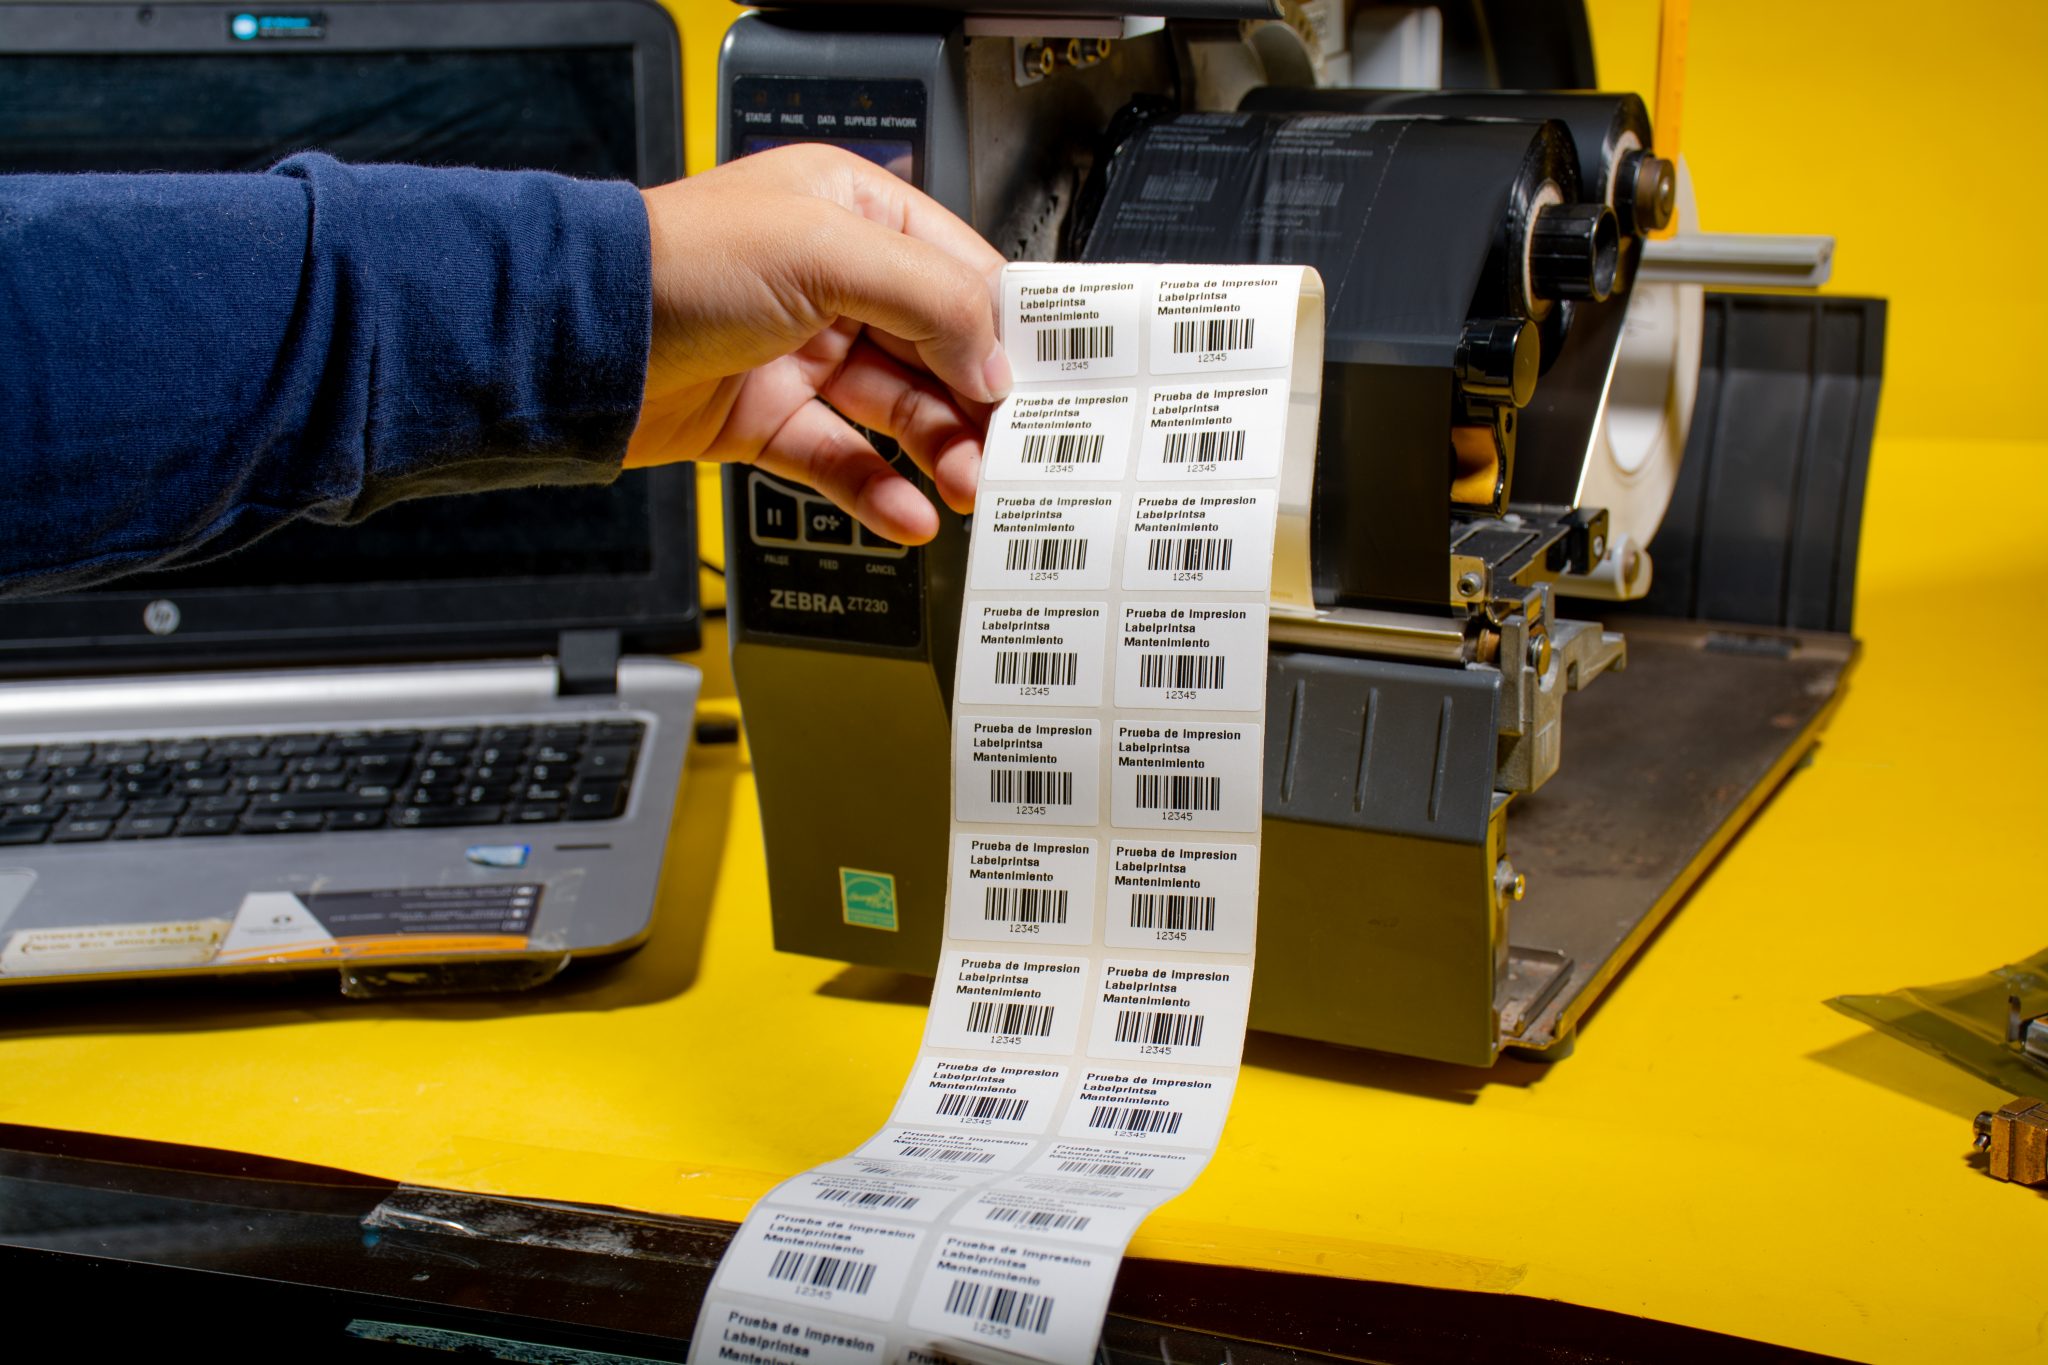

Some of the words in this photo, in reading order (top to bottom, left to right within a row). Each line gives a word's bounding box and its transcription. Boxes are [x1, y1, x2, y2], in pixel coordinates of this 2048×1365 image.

[745, 112, 772, 123] STATUS
[781, 113, 804, 124] PAUSE
[817, 115, 836, 125] DATA
[844, 116, 877, 126] SUPPLIES
[881, 117, 917, 127] NETWORK
[1020, 285, 1059, 296] Prueba
[1062, 284, 1075, 294] de
[1079, 282, 1134, 293] Impresion
[1160, 280, 1200, 289] Prueba
[1203, 280, 1217, 288] de
[1221, 278, 1278, 288] Impresion
[1158, 292, 1227, 302] Labelprintsa
[1020, 298, 1086, 310] Labelprintsa
[1157, 303, 1240, 315] Mantenimiento
[1020, 310, 1099, 324] Mantenimiento
[1197, 352, 1227, 363] 12345
[1061, 360, 1089, 371] 12345
[1015, 397, 1054, 406] Prueba
[1057, 396, 1071, 405] de
[1074, 394, 1129, 406] Impresion
[1153, 391, 1192, 402] Prueba
[1195, 390, 1210, 400] de
[1213, 387, 1268, 399] Impresion
[1012, 409, 1080, 418] Labelprintsa
[1152, 403, 1219, 415] Labelprintsa
[1010, 420, 1092, 429] Mantenimiento
[1150, 415, 1232, 428] Mantenimiento
[1044, 464, 1074, 473] 12345
[1186, 463, 1217, 473] 12345
[996, 497, 1036, 506] Prueba
[1039, 497, 1053, 506] de
[1056, 497, 1112, 507] Impresion
[1138, 497, 1178, 506] Prueba
[1181, 497, 1196, 506] de
[1199, 496, 1256, 507] Impresion
[994, 510, 1062, 520] Labelprintsa
[1136, 509, 1206, 520] Labelprintsa
[993, 523, 1075, 532] Mantenimiento
[1134, 522, 1219, 532] Mantenimiento
[819, 559, 839, 570] FEED
[866, 563, 896, 576] CANCEL
[1029, 571, 1059, 581] 12345
[1172, 572, 1204, 582] 12345
[770, 588, 845, 614] ZEBRA
[847, 596, 888, 613] ZT230
[983, 607, 1022, 617] Prueba
[1026, 607, 1040, 617] de
[1043, 607, 1099, 618] Impresion
[1125, 608, 1167, 618] Prueba
[1170, 608, 1185, 619] de
[1188, 608, 1246, 621] Impresion
[981, 620, 1050, 632] Labelprintsa
[1124, 622, 1196, 634] Labelprintsa
[980, 634, 1064, 645] Mantenimiento
[1123, 636, 1210, 648] Mantenimiento
[1019, 686, 1050, 696] 12345
[1165, 690, 1197, 700] 12345
[974, 722, 1014, 734] Prueba
[1017, 724, 1032, 734] de
[1035, 724, 1092, 736] Impresion
[1119, 727, 1160, 738] Prueba
[1164, 728, 1178, 739] de
[1182, 728, 1241, 741] Impresion
[973, 737, 1043, 750] Labelprintsa
[1118, 741, 1190, 754] Labelprintsa
[973, 751, 1057, 764] Mantenimiento
[1118, 756, 1205, 769] Mantenimiento
[1016, 805, 1046, 815] 12345
[1162, 811, 1193, 821] 12345
[971, 840, 1011, 851] Prueba
[1014, 841, 1029, 852] de
[1033, 842, 1089, 855] Impresion
[1116, 846, 1157, 858] Prueba
[1160, 847, 1175, 858] de
[1179, 848, 1237, 861] Impresion
[970, 854, 1040, 867] Labelprintsa
[1115, 860, 1186, 874] Labelprintsa
[969, 868, 1054, 882] Mantenimiento
[1114, 875, 1201, 889] Mantenimiento
[1009, 923, 1040, 934] 12345
[1156, 931, 1187, 941] 12345
[960, 958, 1002, 970] Prueba
[1005, 960, 1019, 971] de
[1023, 961, 1080, 974] Impresion
[958, 971, 1029, 984] Labelprintsa
[1107, 966, 1149, 978] Prueba
[1152, 968, 1167, 979] de
[1171, 969, 1230, 982] Impresion
[955, 984, 1041, 998] Mantenimiento
[1105, 980, 1177, 993] Labelprintsa
[1102, 993, 1190, 1007] Mantenimiento
[990, 1035, 1022, 1045] 12345
[1140, 1045, 1172, 1055] 12345
[936, 1062, 979, 1072] Prueba
[981, 1065, 997, 1073] de
[1000, 1066, 1059, 1078] Impresion
[932, 1071, 1005, 1084] Labelprintsa
[1086, 1072, 1129, 1083] Prueba
[1132, 1076, 1148, 1084] de
[1151, 1077, 1212, 1089] Impresion
[928, 1080, 1017, 1094] Mantenimiento
[1083, 1083, 1157, 1095] Labelprintsa
[1079, 1092, 1170, 1106] Mantenimiento
[959, 1117, 992, 1126] 12345
[1114, 1130, 1147, 1139] 12345
